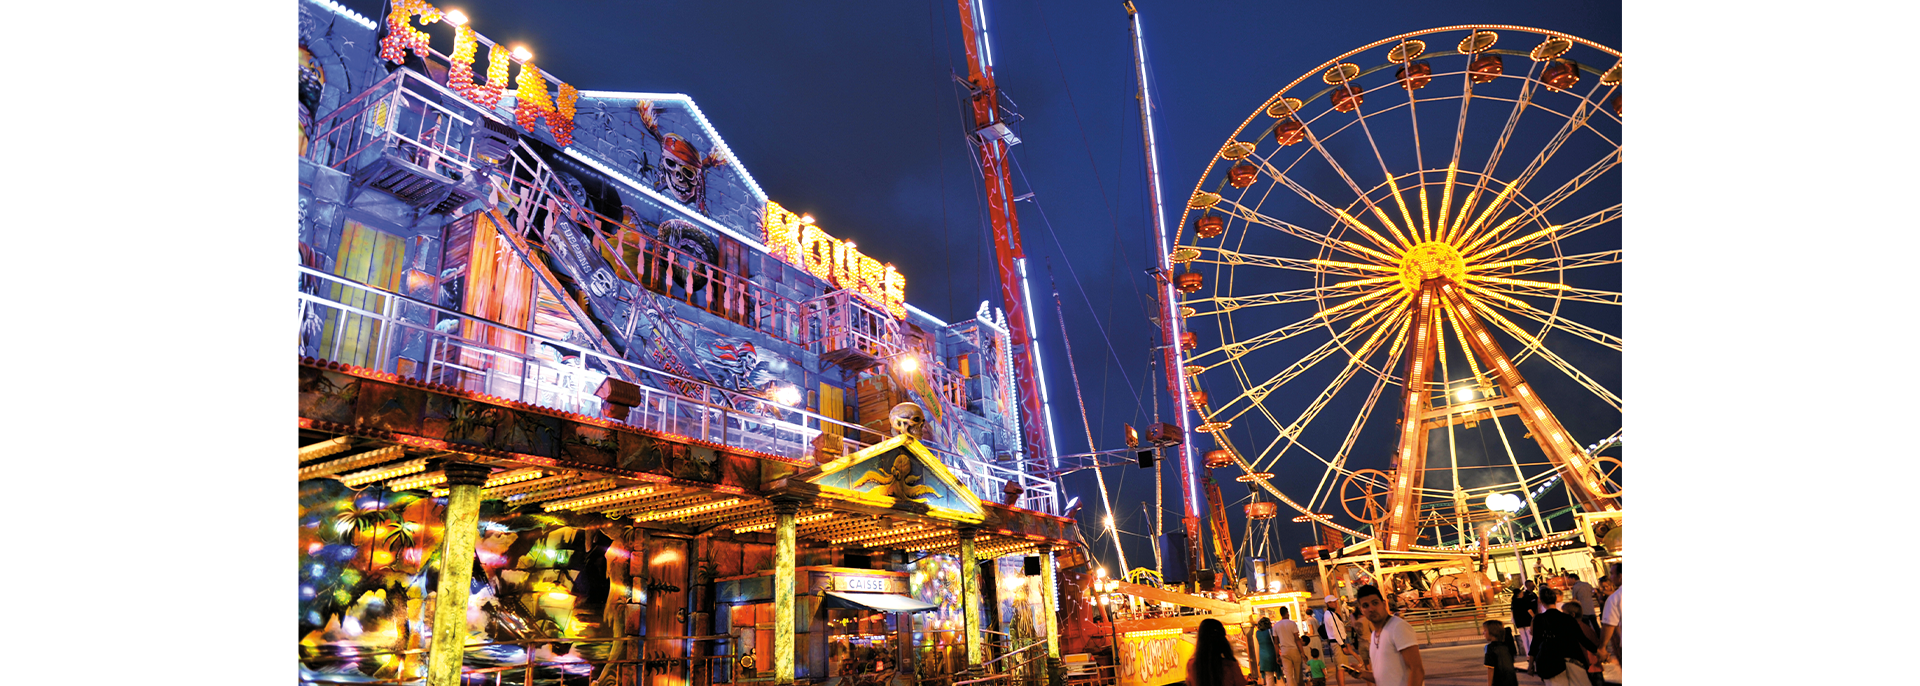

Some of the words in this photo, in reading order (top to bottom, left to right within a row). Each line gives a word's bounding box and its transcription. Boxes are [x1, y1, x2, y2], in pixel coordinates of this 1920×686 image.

[379, 0, 579, 147] FUN
[766, 200, 908, 322] HOUSE
[653, 349, 664, 364] ET
[654, 336, 662, 346] A
[662, 341, 677, 364] VOS
[848, 579, 883, 590] CAISSE
